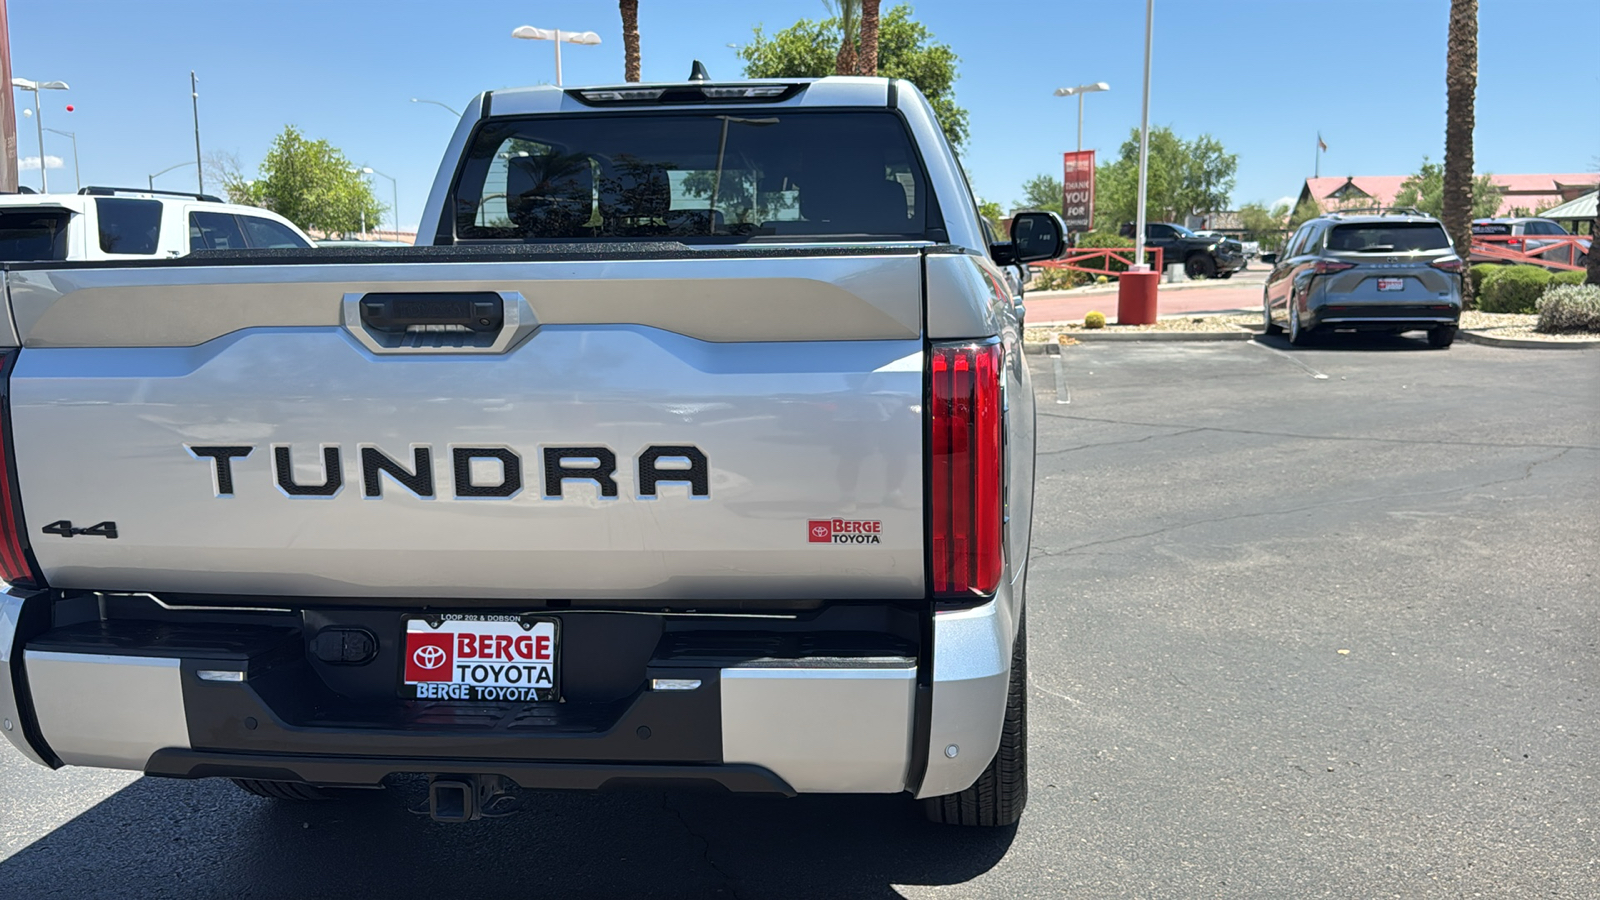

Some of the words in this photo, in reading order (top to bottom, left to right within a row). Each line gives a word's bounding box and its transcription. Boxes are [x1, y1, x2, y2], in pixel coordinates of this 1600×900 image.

[1065, 181, 1089, 190] THANK
[1065, 192, 1089, 204] YOU
[1067, 206, 1085, 216] FOR
[184, 442, 711, 500] TUNDRA
[832, 519, 881, 534] BERGE
[832, 534, 880, 544] TOYOTA
[457, 633, 551, 662] BERGE
[457, 665, 552, 684] TOYOTA
[416, 682, 471, 700] BERGE
[475, 686, 539, 701] TOYOTA
